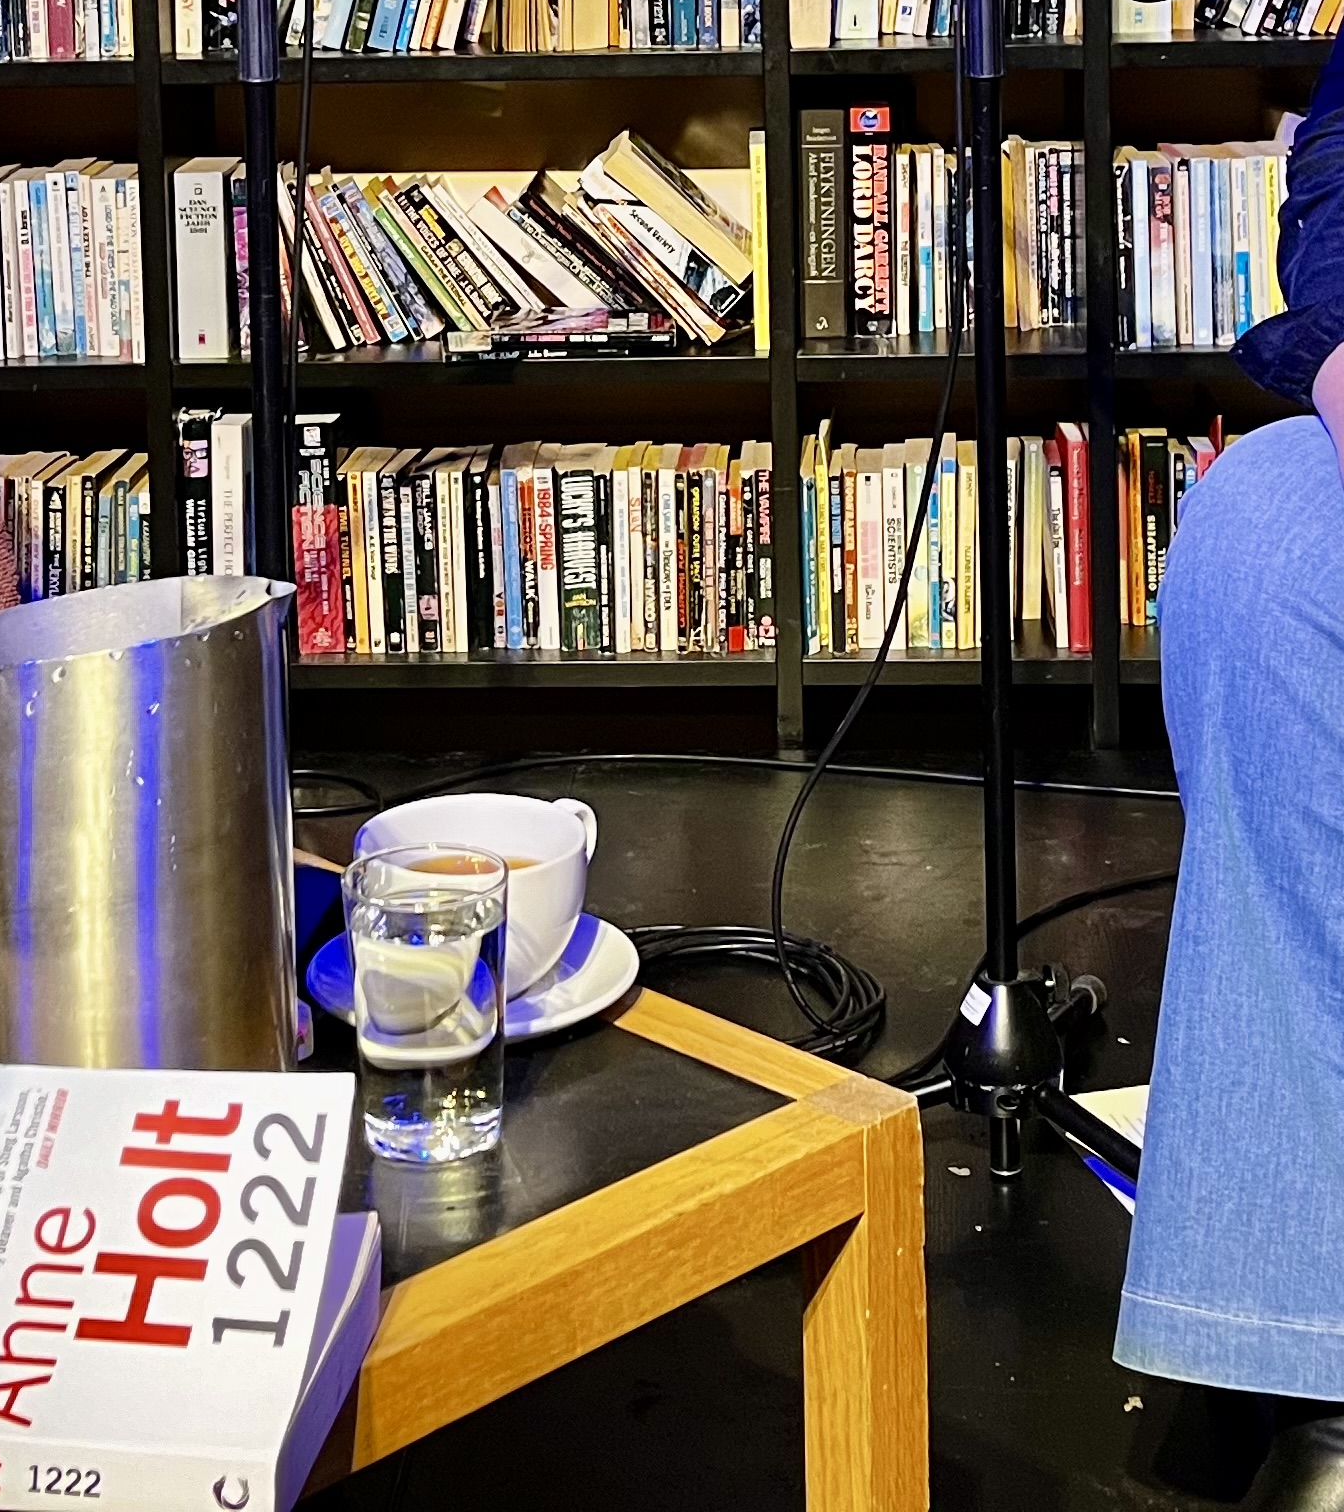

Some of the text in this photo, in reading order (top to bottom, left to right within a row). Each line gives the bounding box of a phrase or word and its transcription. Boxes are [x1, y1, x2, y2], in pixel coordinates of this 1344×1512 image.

[630, 208, 677, 254] Second Variety
[821, 153, 836, 278] FLYKTNINGEN
[853, 144, 874, 313] LORD DARCY
[874, 144, 889, 314] RANDALL GARRETT
[808, 244, 820, 277] biografi
[187, 499, 196, 577] WILLIAM GIBS
[196, 499, 206, 544] Virtual
[224, 489, 233, 577] THE PERFECT HO
[299, 471, 313, 549] FICTION
[312, 460, 324, 548] SCIENCE
[423, 479, 434, 550] BILL JAMES
[561, 475, 595, 588] LUCKY'S HARVEST
[758, 471, 770, 545] THE VAMPIRE
[339, 506, 350, 580] TIME TUNNEL
[538, 522, 555, 570] SPRING
[887, 518, 897, 585] SCIENTISTS
[525, 561, 536, 600] WALK
[13, 1142, 34, 1182] Agatha
[36, 1135, 55, 1169] DAILY
[8, 1186, 22, 1208] and
[73, 1099, 244, 1349] Holt
[211, 1113, 328, 1348] 1222
[26, 1464, 102, 1498] 1222
